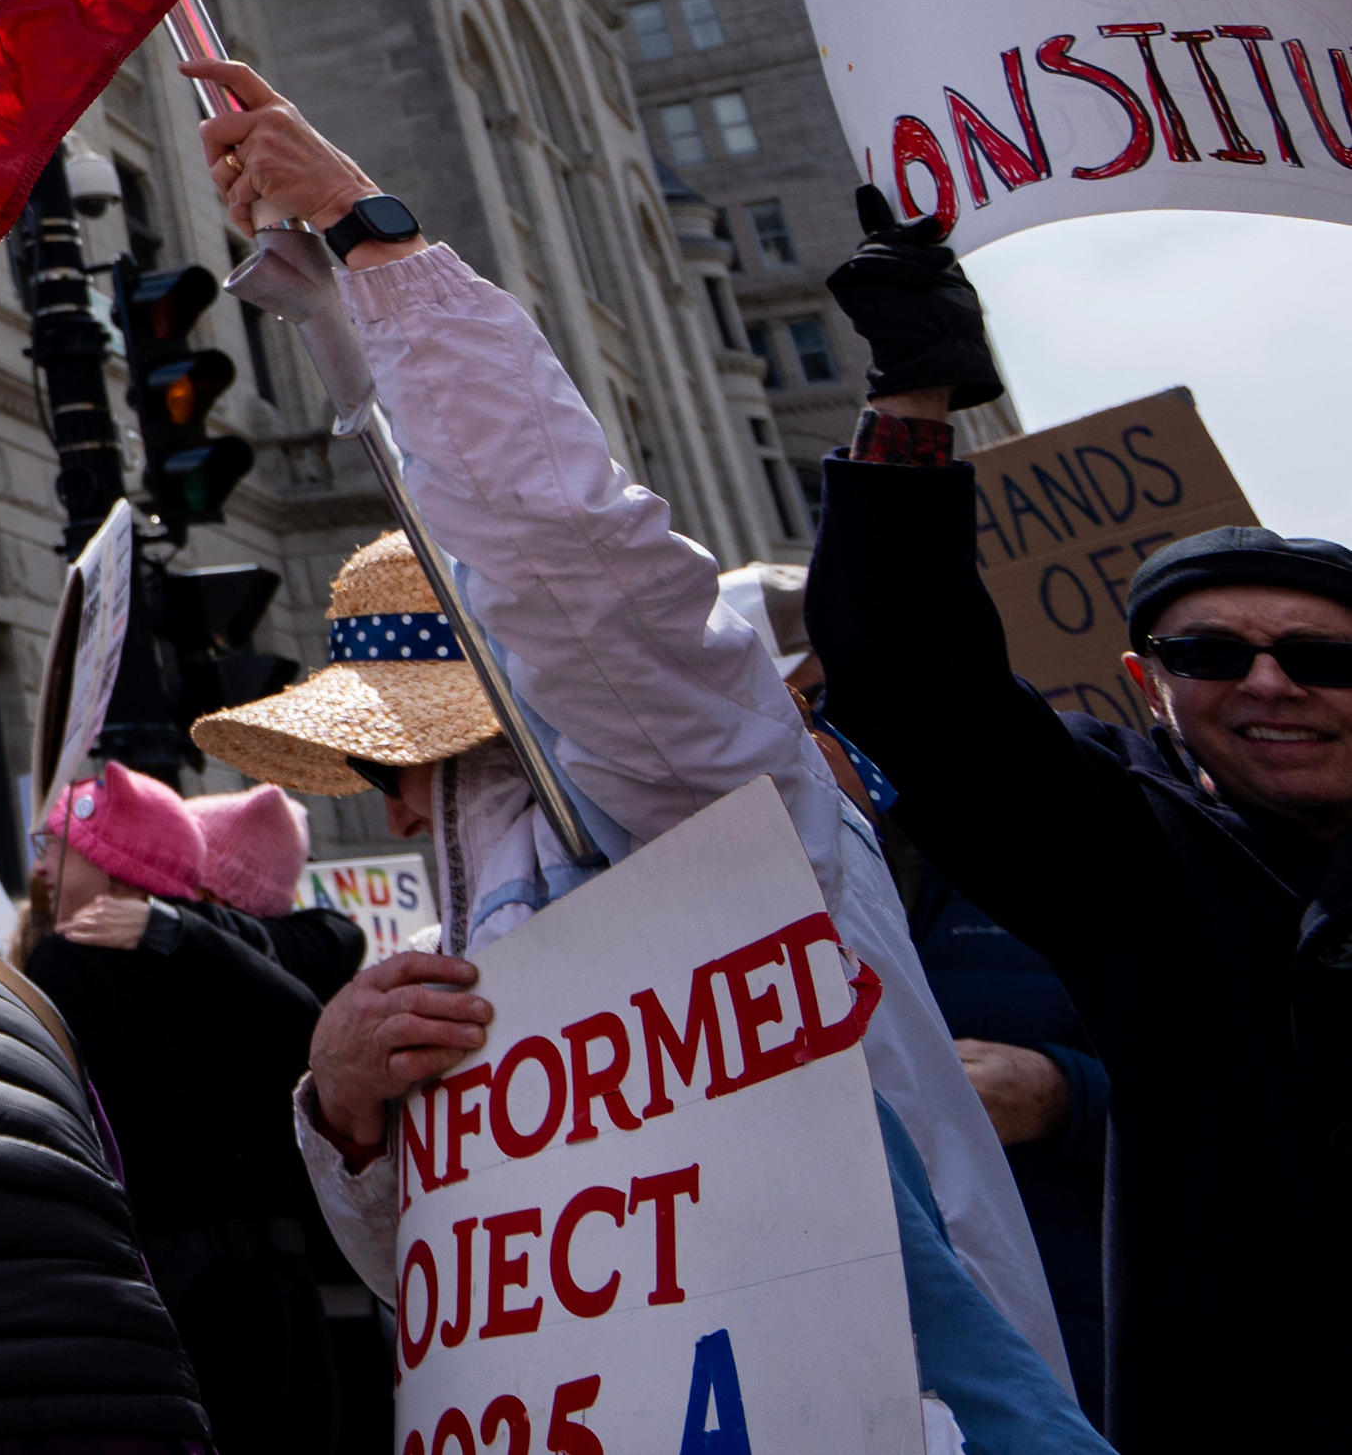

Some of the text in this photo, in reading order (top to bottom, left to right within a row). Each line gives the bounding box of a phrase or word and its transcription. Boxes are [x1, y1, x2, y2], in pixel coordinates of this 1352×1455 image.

[865, 22, 1352, 240] ONSTITU
[295, 867, 419, 912] ANDS
[400, 912, 883, 1211] NFORMED
[394, 1164, 700, 1388] OJECT
